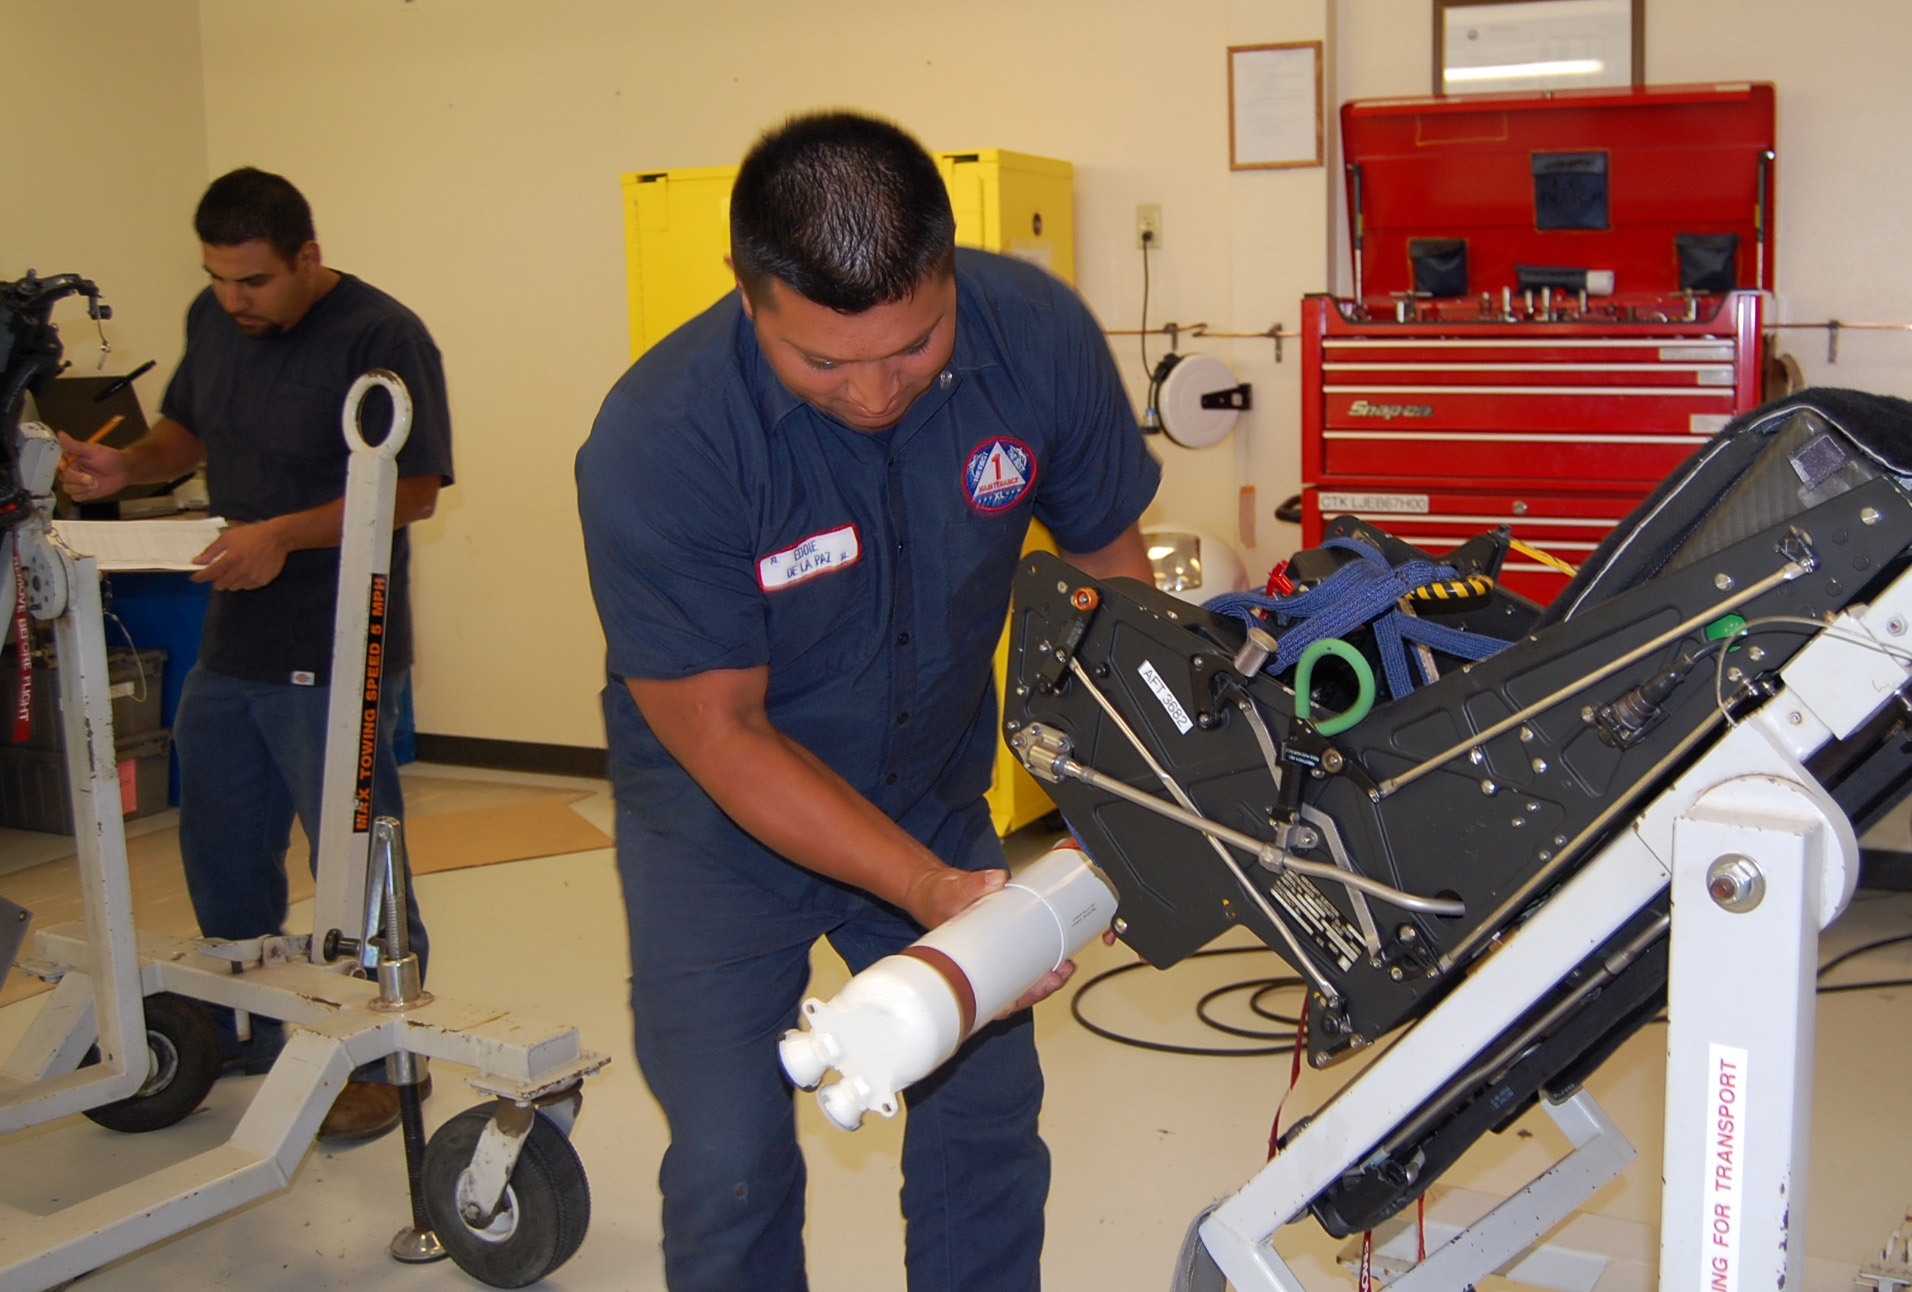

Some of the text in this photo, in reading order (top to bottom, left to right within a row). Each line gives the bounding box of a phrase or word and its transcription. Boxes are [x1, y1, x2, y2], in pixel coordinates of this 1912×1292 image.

[991, 453, 1001, 480] 1
[787, 551, 832, 578] DE LA PAZ
[793, 540, 818, 561] EDDIE
[14, 556, 32, 722] REMOVE BEFORE FLIGHT
[355, 577, 387, 830] MAX TOWING SPEED 5 MPH
[1143, 669, 1188, 728] AFT 3682
[1715, 1057, 1737, 1192] TRANSPORT
[1713, 1203, 1731, 1249] FOR
